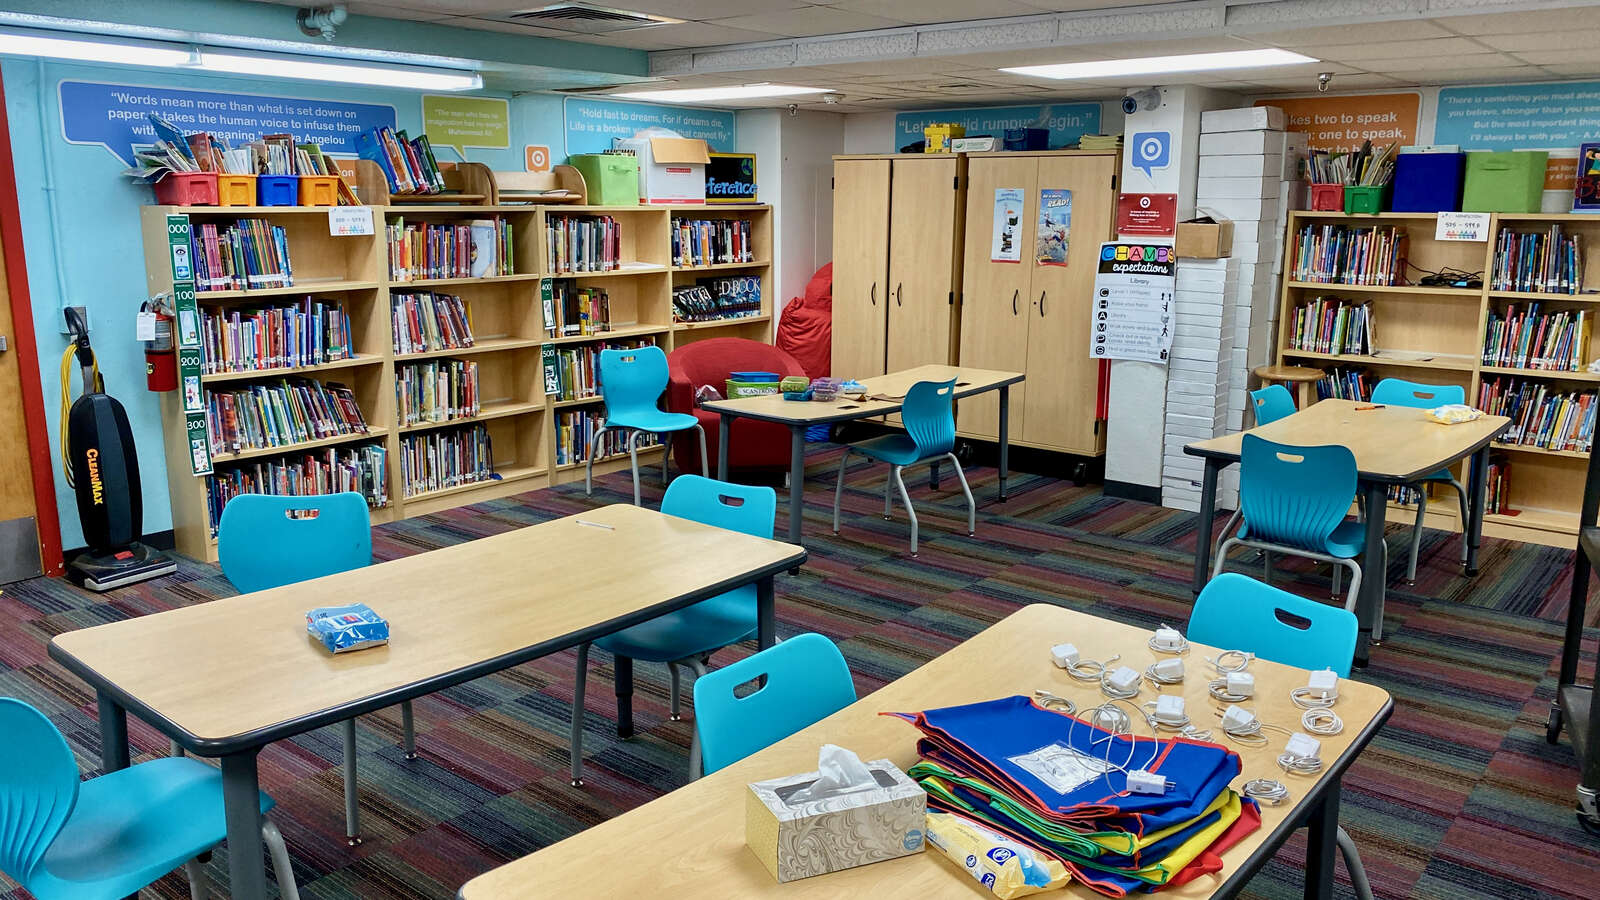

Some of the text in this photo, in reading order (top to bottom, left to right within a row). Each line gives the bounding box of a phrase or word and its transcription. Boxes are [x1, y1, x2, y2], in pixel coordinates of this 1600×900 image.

[1484, 93, 1530, 103] something
[1532, 92, 1550, 103] you
[1551, 90, 1575, 100] must
[160, 98, 194, 108] mean
[197, 100, 227, 110] more
[229, 101, 254, 112] than
[257, 103, 283, 114] what
[285, 105, 294, 115] is
[297, 107, 313, 115] set
[315, 107, 342, 118] down
[344, 111, 357, 119] on
[1448, 110, 1464, 118] you
[1502, 107, 1539, 115] stronger
[1542, 105, 1563, 113] than
[1565, 105, 1583, 114] you
[108, 109, 148, 120] paper.
[162, 112, 195, 123] takes
[198, 113, 217, 124] the
[220, 114, 257, 126] human
[260, 119, 289, 128] voice
[291, 120, 300, 129] to
[304, 120, 335, 131] infuse
[336, 121, 361, 132] them
[603, 109, 619, 120] fast
[621, 111, 628, 121] to
[662, 114, 675, 124] For
[676, 115, 682, 124] if
[684, 117, 710, 126] dreams
[1314, 114, 1338, 125] two
[1341, 113, 1354, 124] to
[1357, 111, 1397, 125] speak
[1474, 121, 1489, 129] But
[1491, 120, 1505, 128] the
[1507, 119, 1529, 128] most
[1532, 118, 1577, 129] important
[569, 120, 585, 131] Life
[587, 122, 594, 130] is
[603, 123, 631, 133] broken
[693, 129, 717, 139] cannot
[1319, 131, 1343, 140] one
[1346, 129, 1359, 140] to
[1362, 127, 1407, 141] speak,
[304, 134, 345, 146] Angelou
[1483, 133, 1513, 142] always
[1528, 132, 1549, 140] with
[1102, 246, 1174, 262] CHAMPS
[1112, 262, 1168, 275] expectations
[542, 283, 551, 291] 400
[1130, 277, 1149, 285] Library
[176, 290, 194, 300] 100
[1098, 312, 1107, 320] A
[543, 350, 554, 358] 500
[1096, 346, 1105, 355] S
[181, 356, 199, 366] 200
[187, 420, 205, 430] 300
